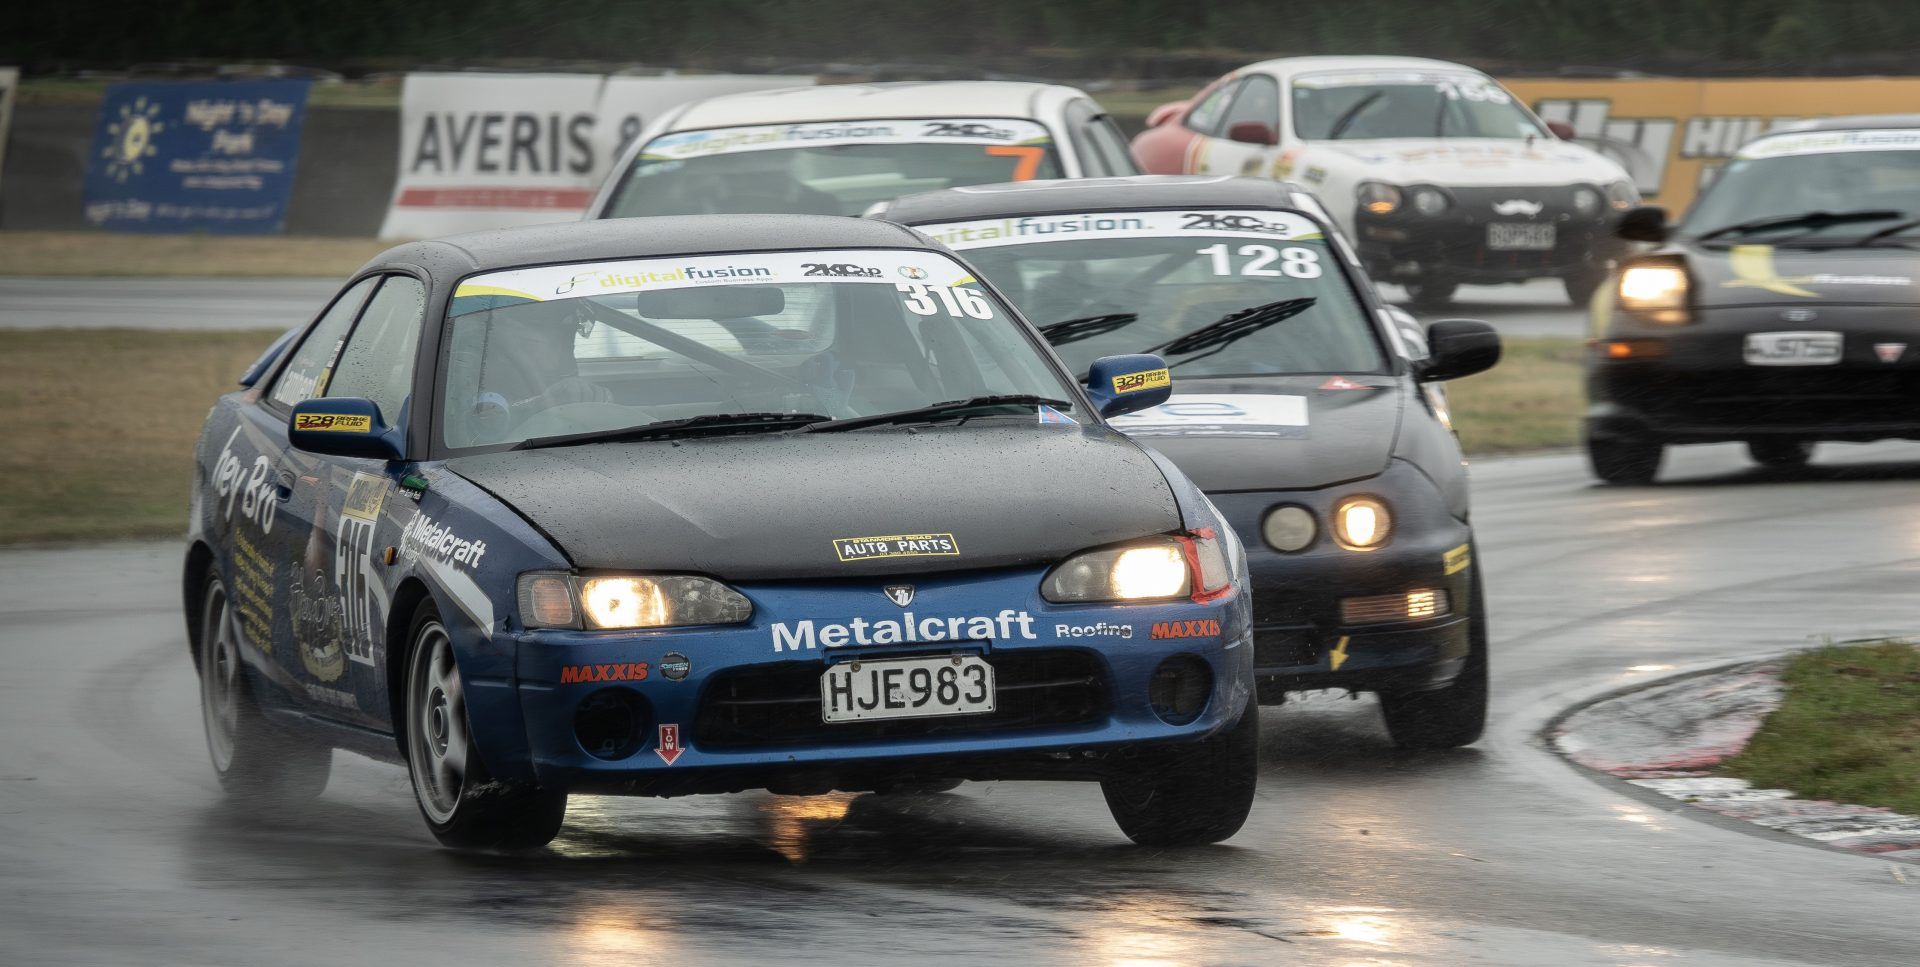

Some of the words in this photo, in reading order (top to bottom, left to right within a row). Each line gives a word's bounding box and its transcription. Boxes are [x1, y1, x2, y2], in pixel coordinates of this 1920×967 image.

[411, 114, 596, 176] AVERIS
[985, 145, 1045, 182] 7
[1197, 244, 1323, 279] 128
[895, 282, 994, 320] 316
[1117, 374, 1145, 388] 328
[299, 415, 335, 425] 328
[241, 455, 278, 536] Bro
[412, 513, 487, 569] Metalcraft
[898, 540, 952, 551] PARTS
[771, 608, 1038, 653] Metalcraft
[1055, 621, 1133, 640] Roofing
[561, 662, 649, 684] MAXXIS
[829, 663, 988, 712] HJE983
[664, 727, 674, 750] TOW
